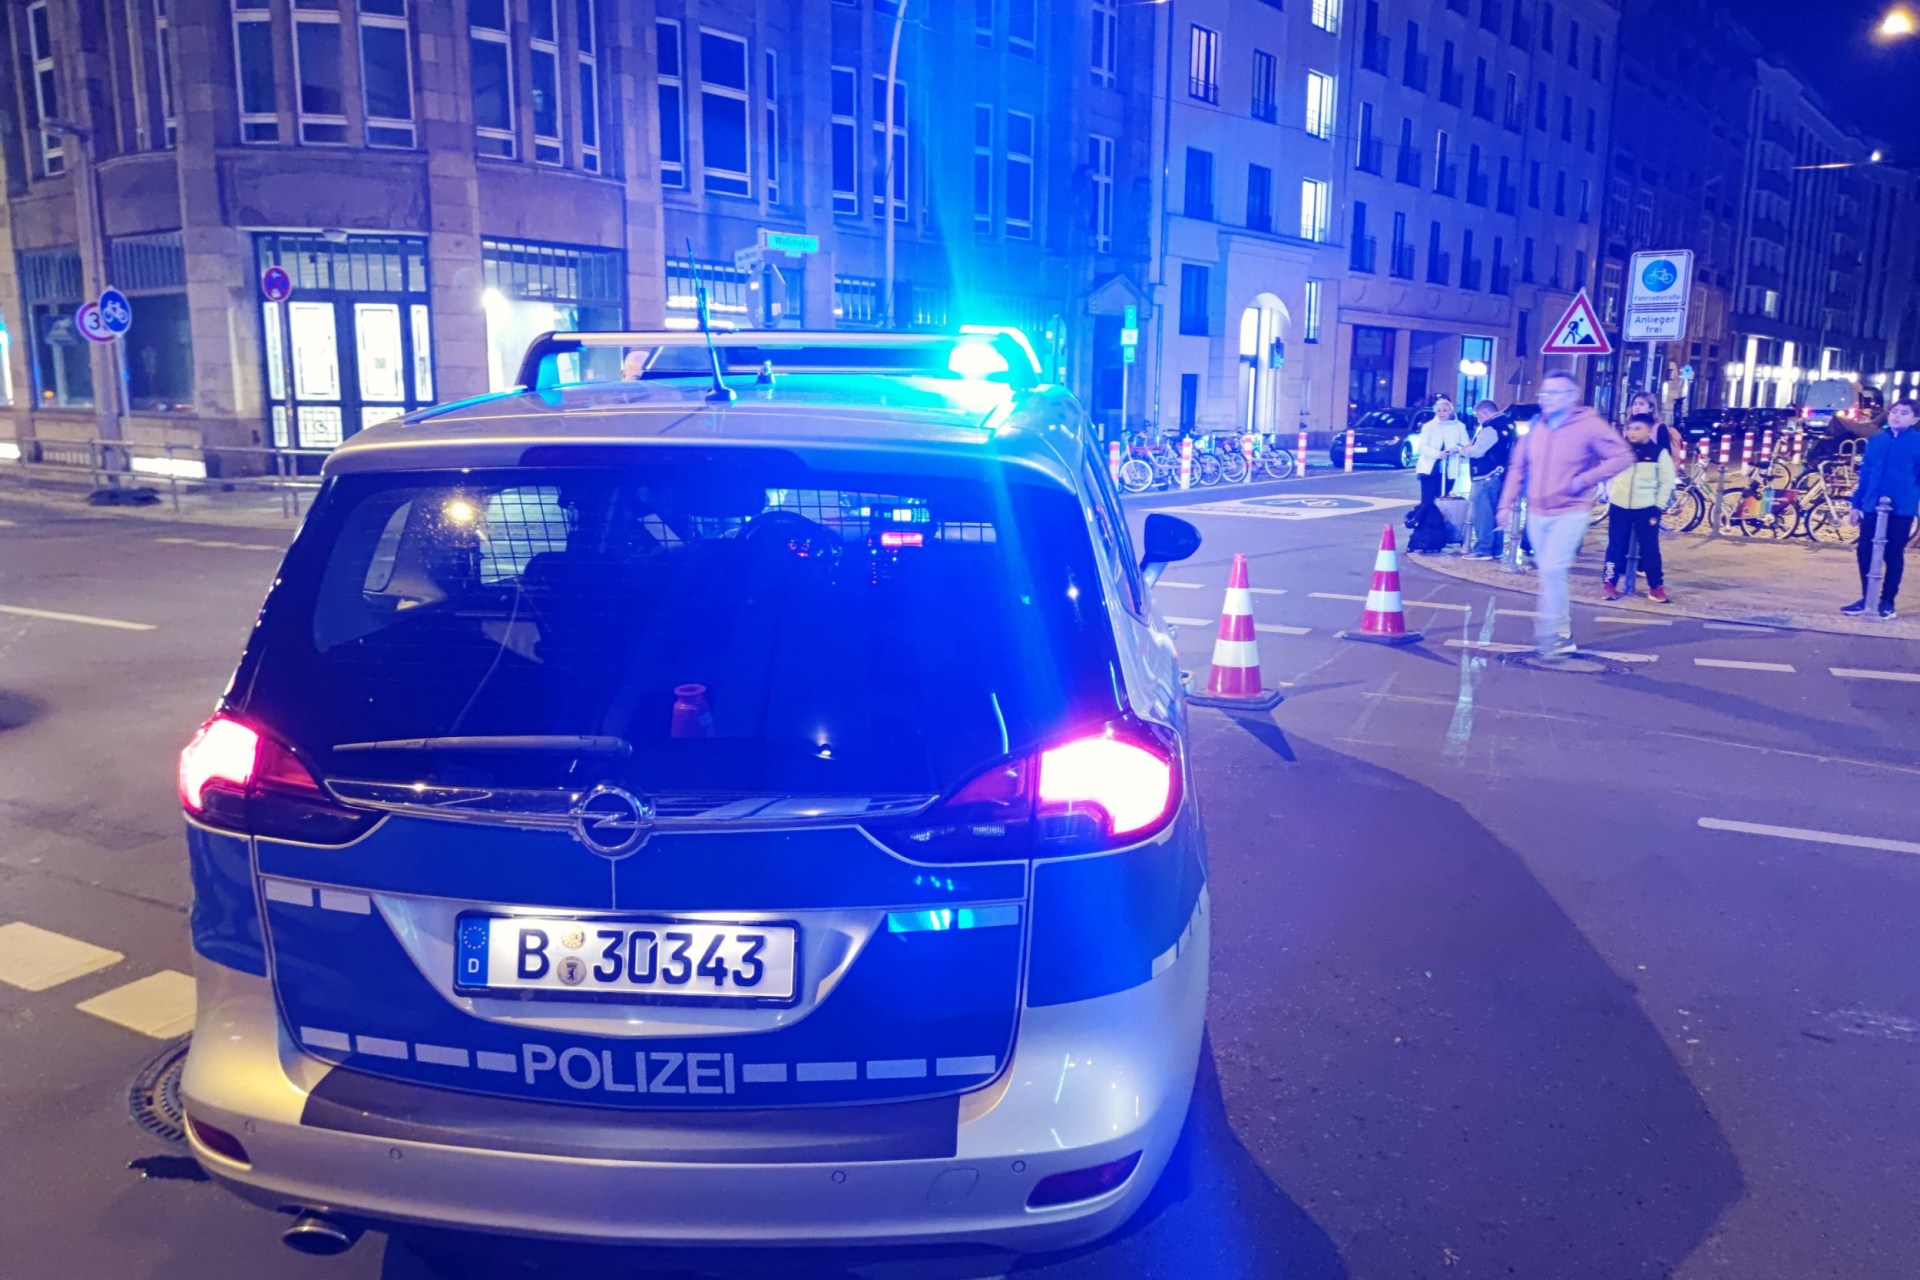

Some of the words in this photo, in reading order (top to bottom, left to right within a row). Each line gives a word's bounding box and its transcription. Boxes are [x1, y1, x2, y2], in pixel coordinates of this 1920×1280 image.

[1635, 315, 1676, 325] Anlieger
[1646, 326, 1662, 334] frei
[517, 927, 550, 980] B
[593, 929, 765, 987] 30343
[467, 958, 480, 974] D
[522, 1043, 736, 1095] POLIZEI
